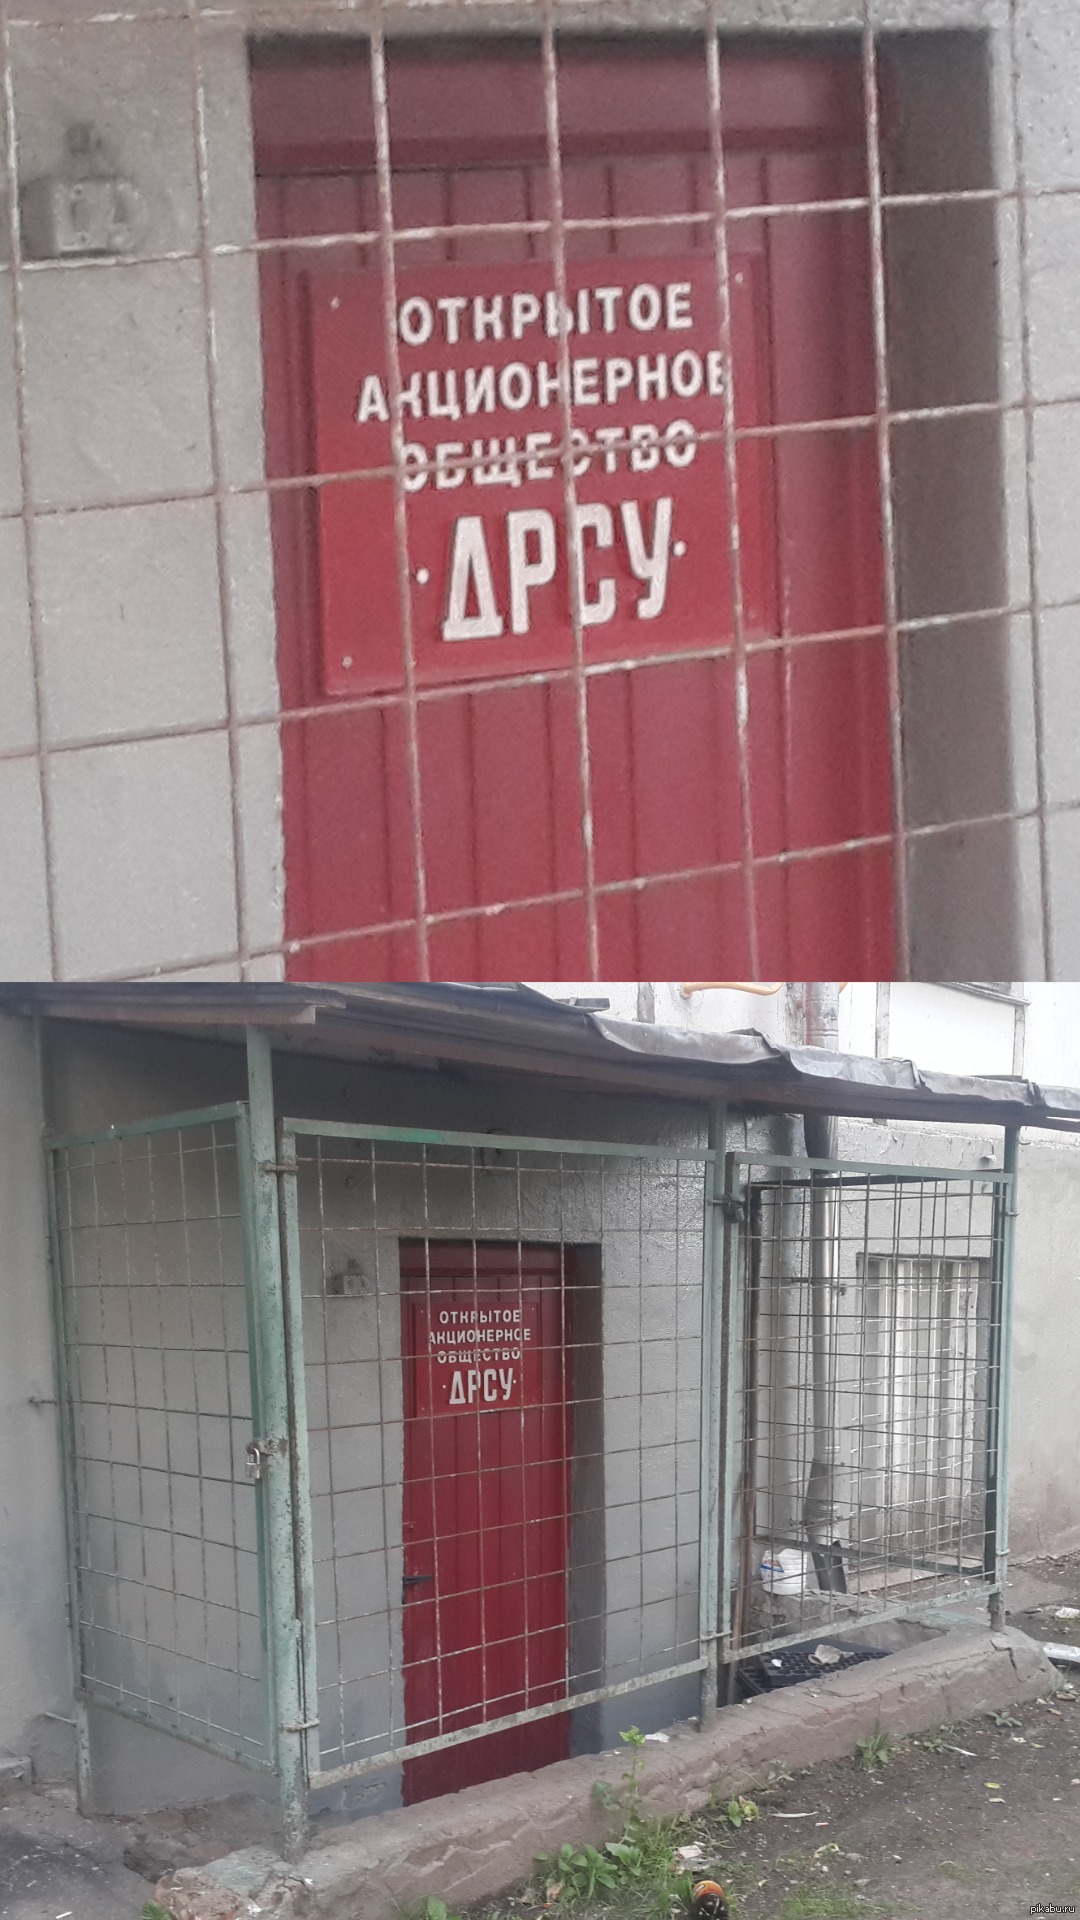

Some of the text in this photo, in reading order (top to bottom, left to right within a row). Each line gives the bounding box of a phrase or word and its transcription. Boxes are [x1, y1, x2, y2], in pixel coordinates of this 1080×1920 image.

[399, 282, 693, 346] ОТКРЫТОЕ
[356, 349, 728, 423] АКЦИОНЕРНОЕ
[399, 419, 697, 492] ОБЩЕСТВО
[429, 1328, 531, 1345] АКЦИОНЕРНОЕ
[439, 1309, 521, 1324] ОТКРЫТОЕ
[437, 1347, 521, 1364] ОБЩЕСТВО
